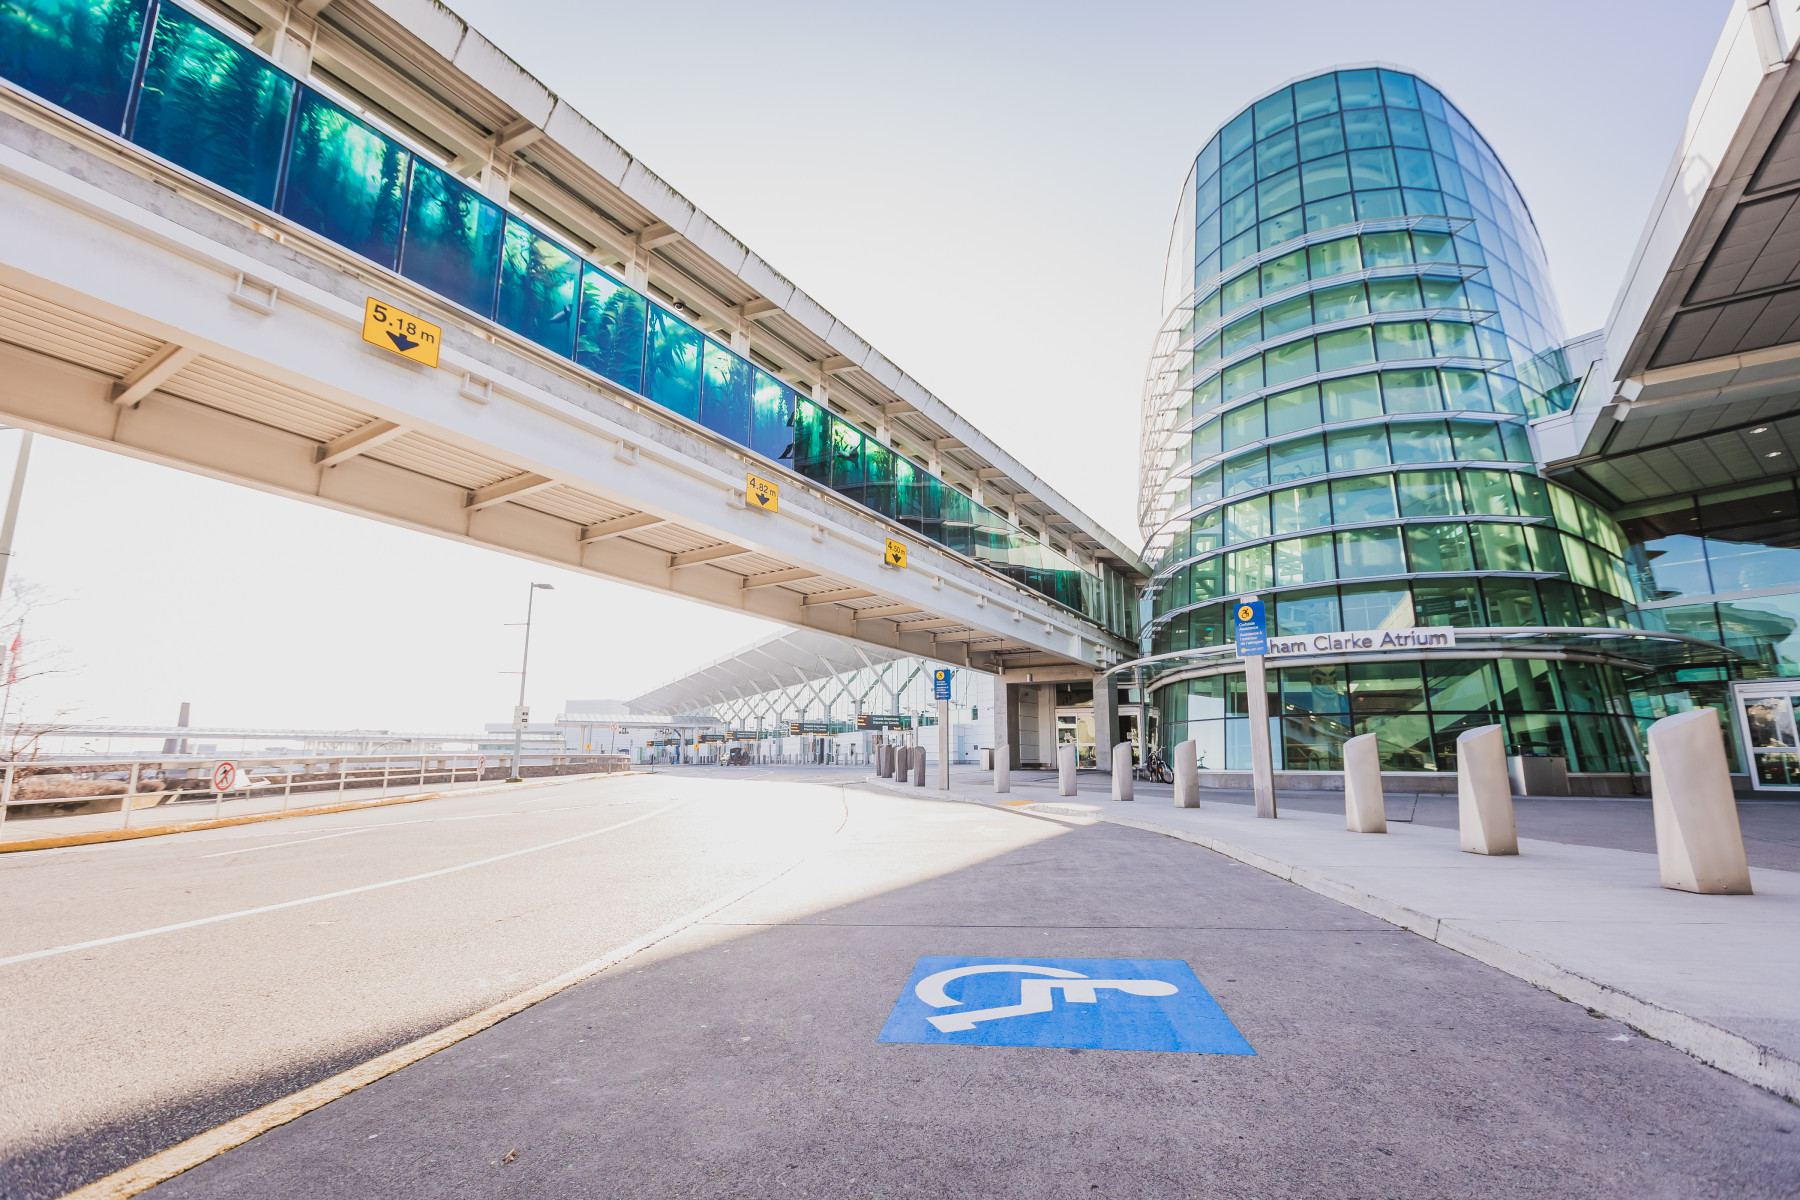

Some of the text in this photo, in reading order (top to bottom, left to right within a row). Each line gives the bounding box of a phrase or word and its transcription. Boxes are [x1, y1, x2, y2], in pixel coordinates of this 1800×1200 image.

[372, 304, 434, 344] 5.18 m
[750, 478, 768, 493] 4.82
[1267, 630, 1449, 655] ham Clarke Atrium
